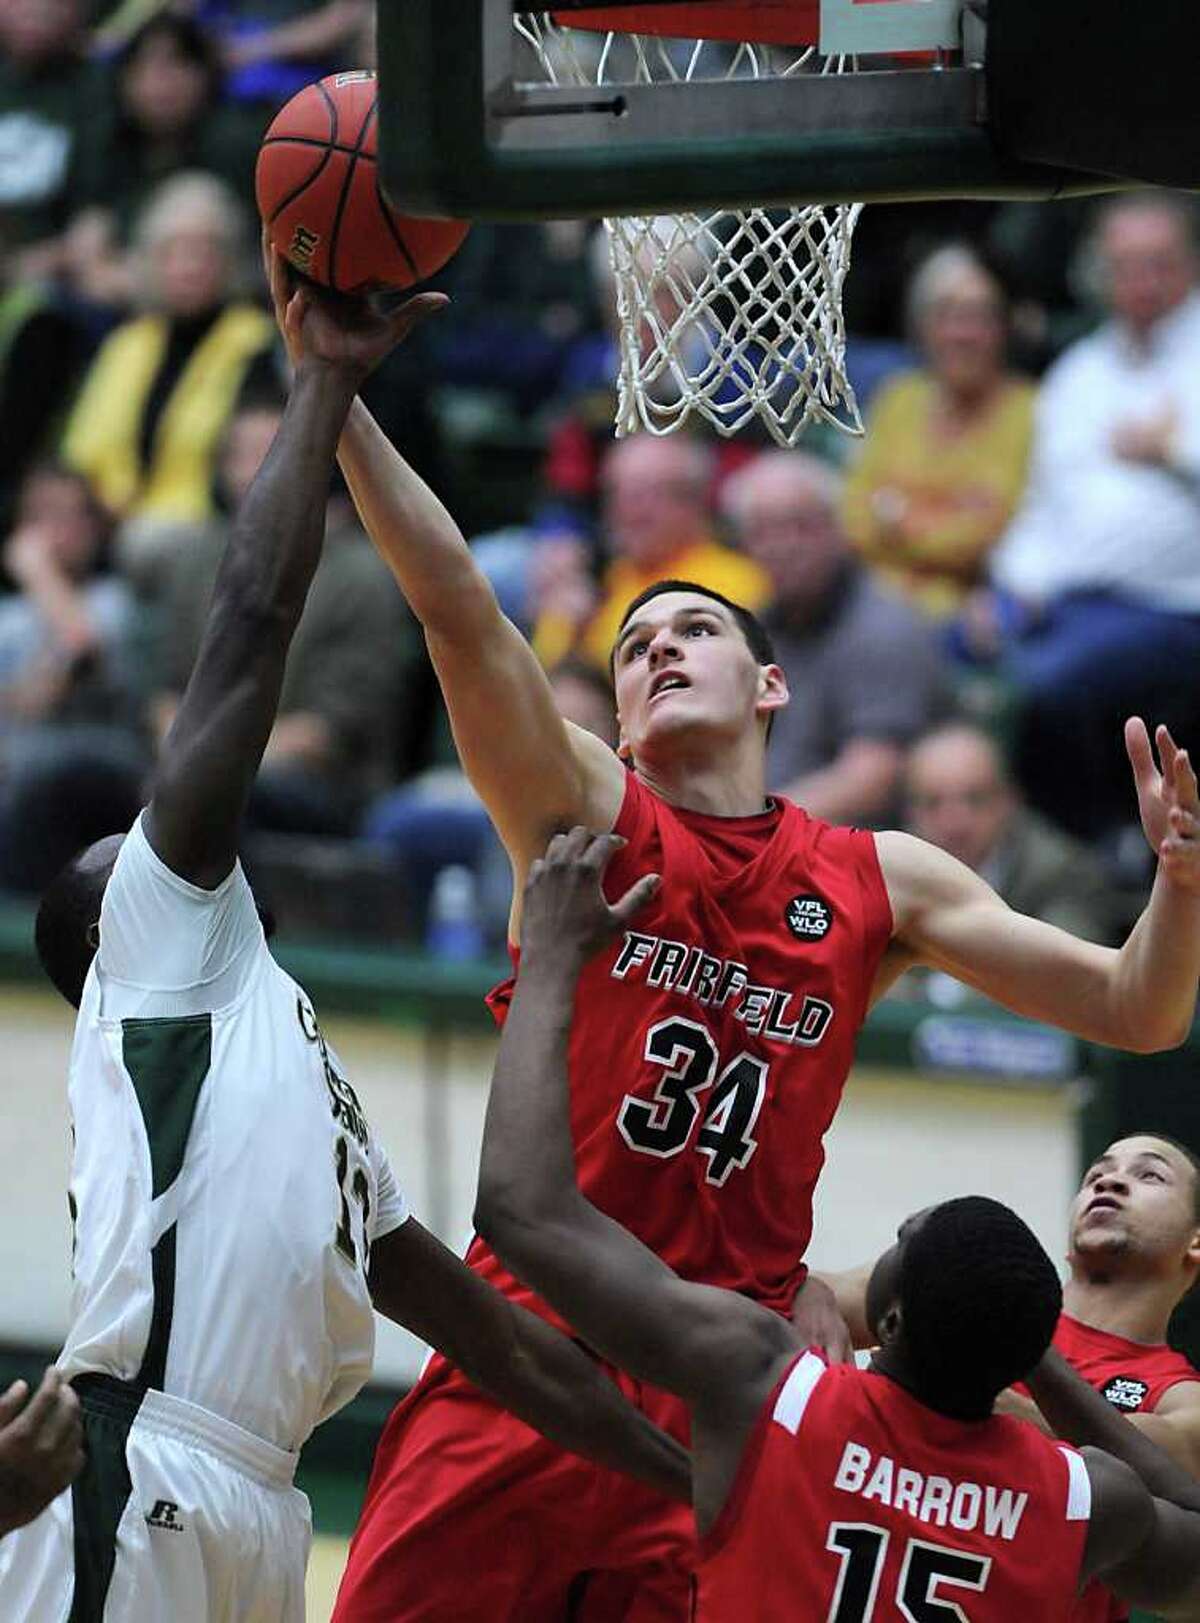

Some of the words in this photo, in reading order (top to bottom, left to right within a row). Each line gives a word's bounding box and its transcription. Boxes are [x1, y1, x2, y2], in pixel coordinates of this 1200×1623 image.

[789, 915, 828, 930] WLO
[793, 900, 827, 913] VFL
[611, 932, 833, 1047] FAIRFELD
[616, 1015, 769, 1188] 34
[833, 1441, 1028, 1540] BARROW
[825, 1521, 992, 1623] 15
